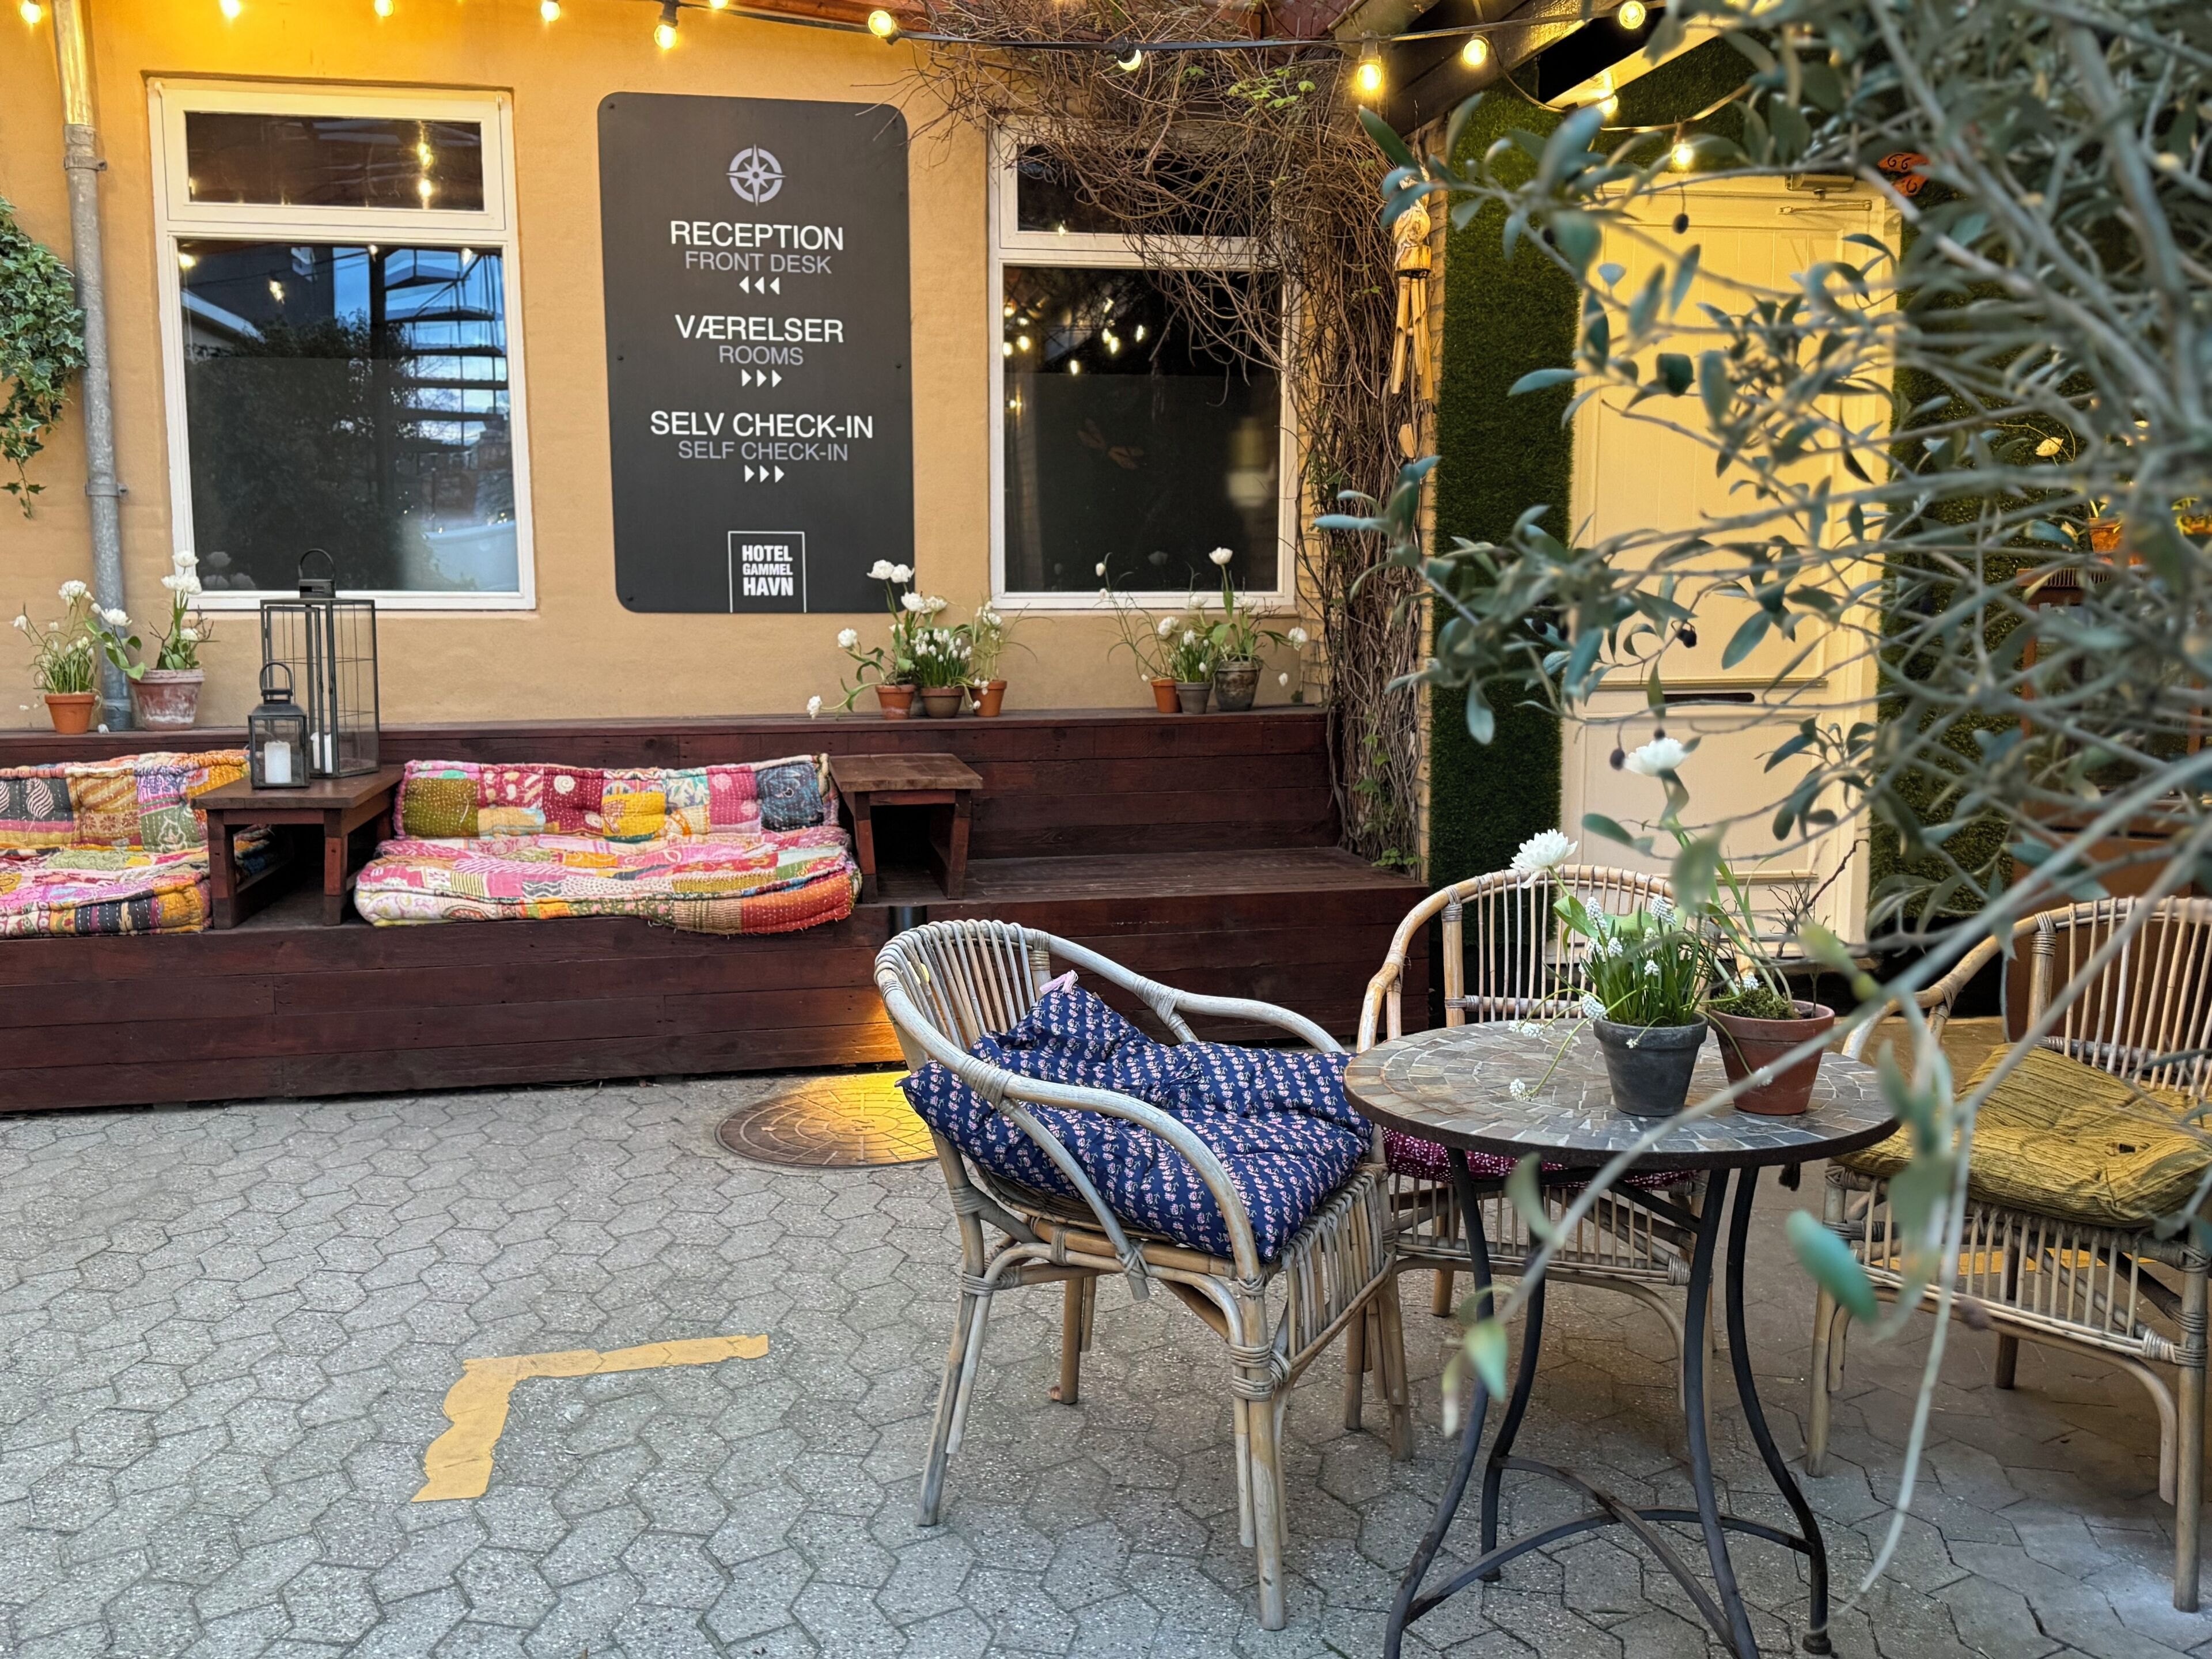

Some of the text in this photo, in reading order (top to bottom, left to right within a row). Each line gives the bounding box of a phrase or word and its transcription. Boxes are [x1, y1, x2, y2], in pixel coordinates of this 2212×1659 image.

[670, 220, 844, 251] RECEPTION
[685, 251, 832, 274] FRONT DESK
[675, 314, 844, 343] VÆRELSER
[719, 345, 804, 366] ROOMS
[650, 410, 873, 439] SELV CHECK-IN
[678, 440, 848, 461] SELF CHECK-IN
[741, 544, 793, 562] HOTEL
[742, 563, 793, 576] GAMMEL
[743, 577, 794, 596] HAVN
